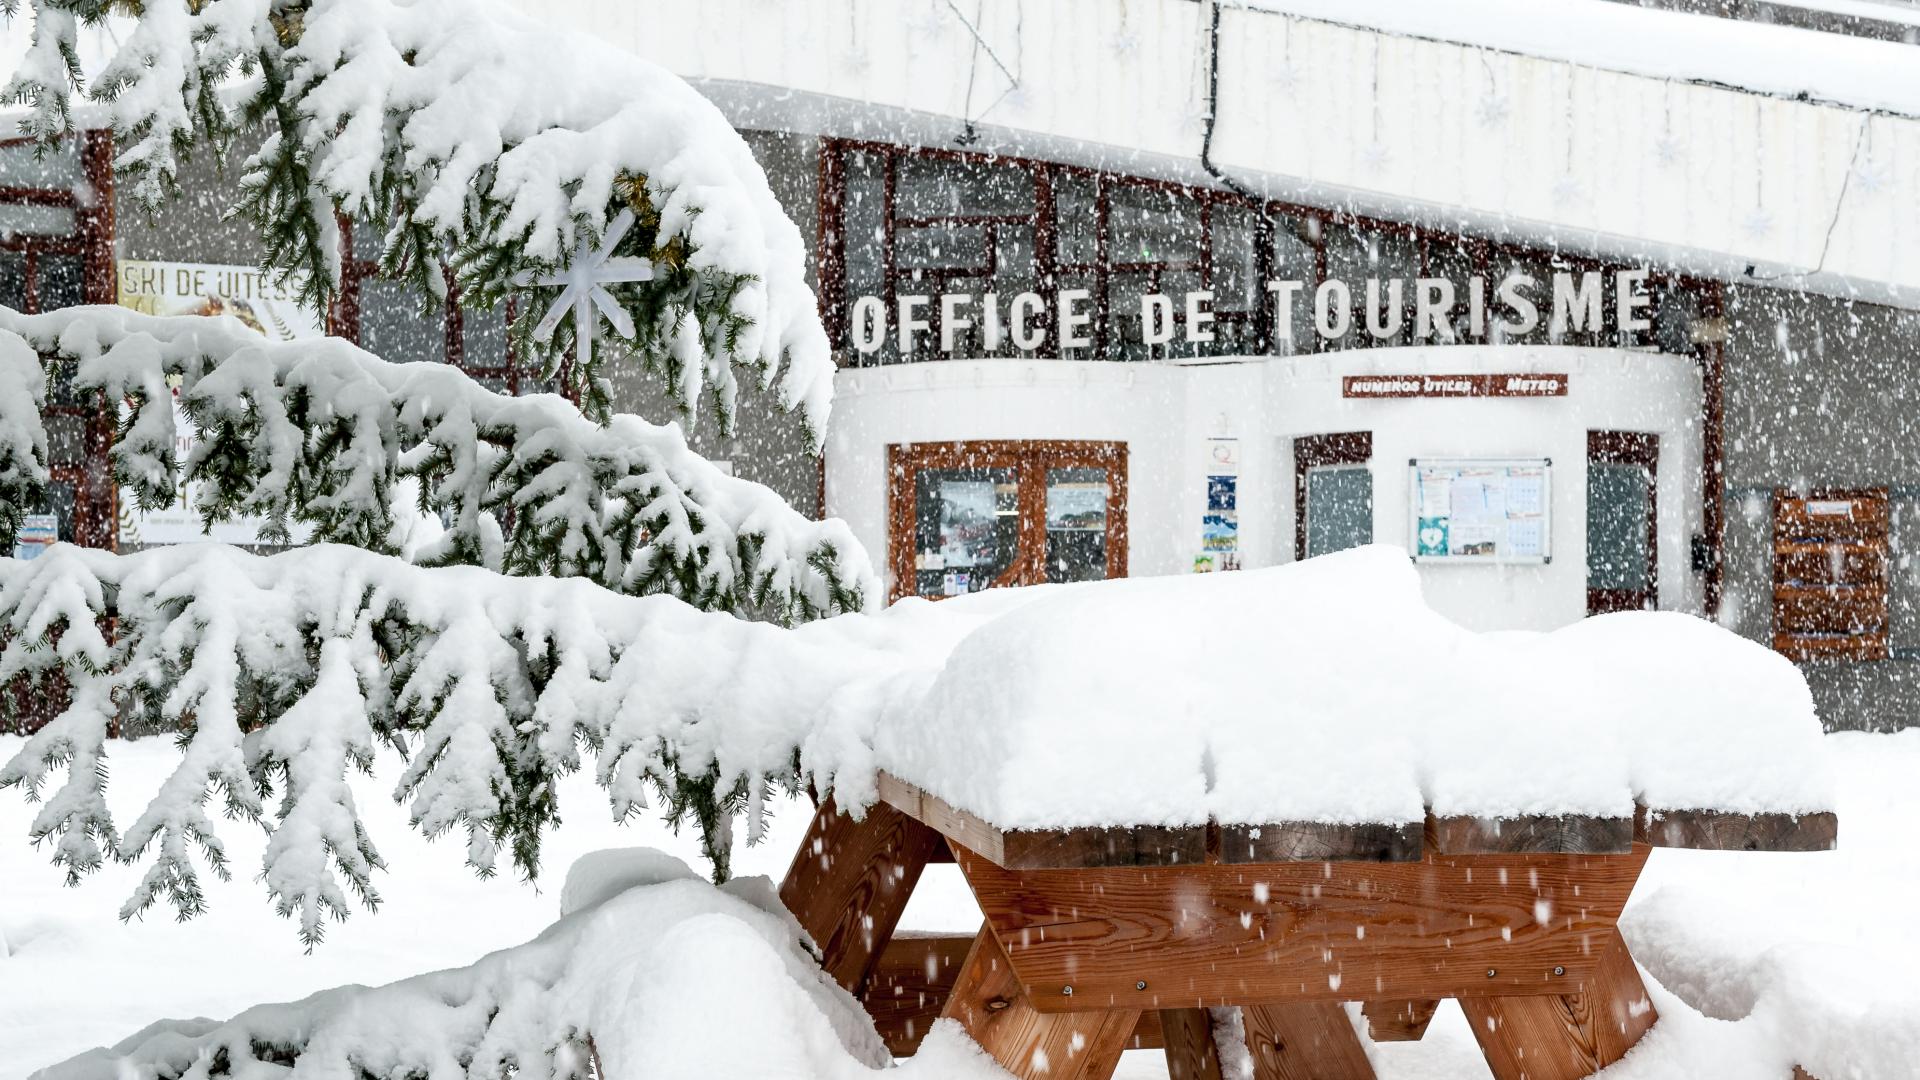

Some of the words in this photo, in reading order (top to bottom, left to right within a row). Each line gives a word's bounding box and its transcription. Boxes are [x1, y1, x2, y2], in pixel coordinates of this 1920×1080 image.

[124, 266, 166, 296] SKI
[177, 269, 206, 297] DE
[851, 289, 1091, 354] OFFICE
[1141, 290, 1216, 346] DE
[1268, 268, 1652, 340] TOURISME
